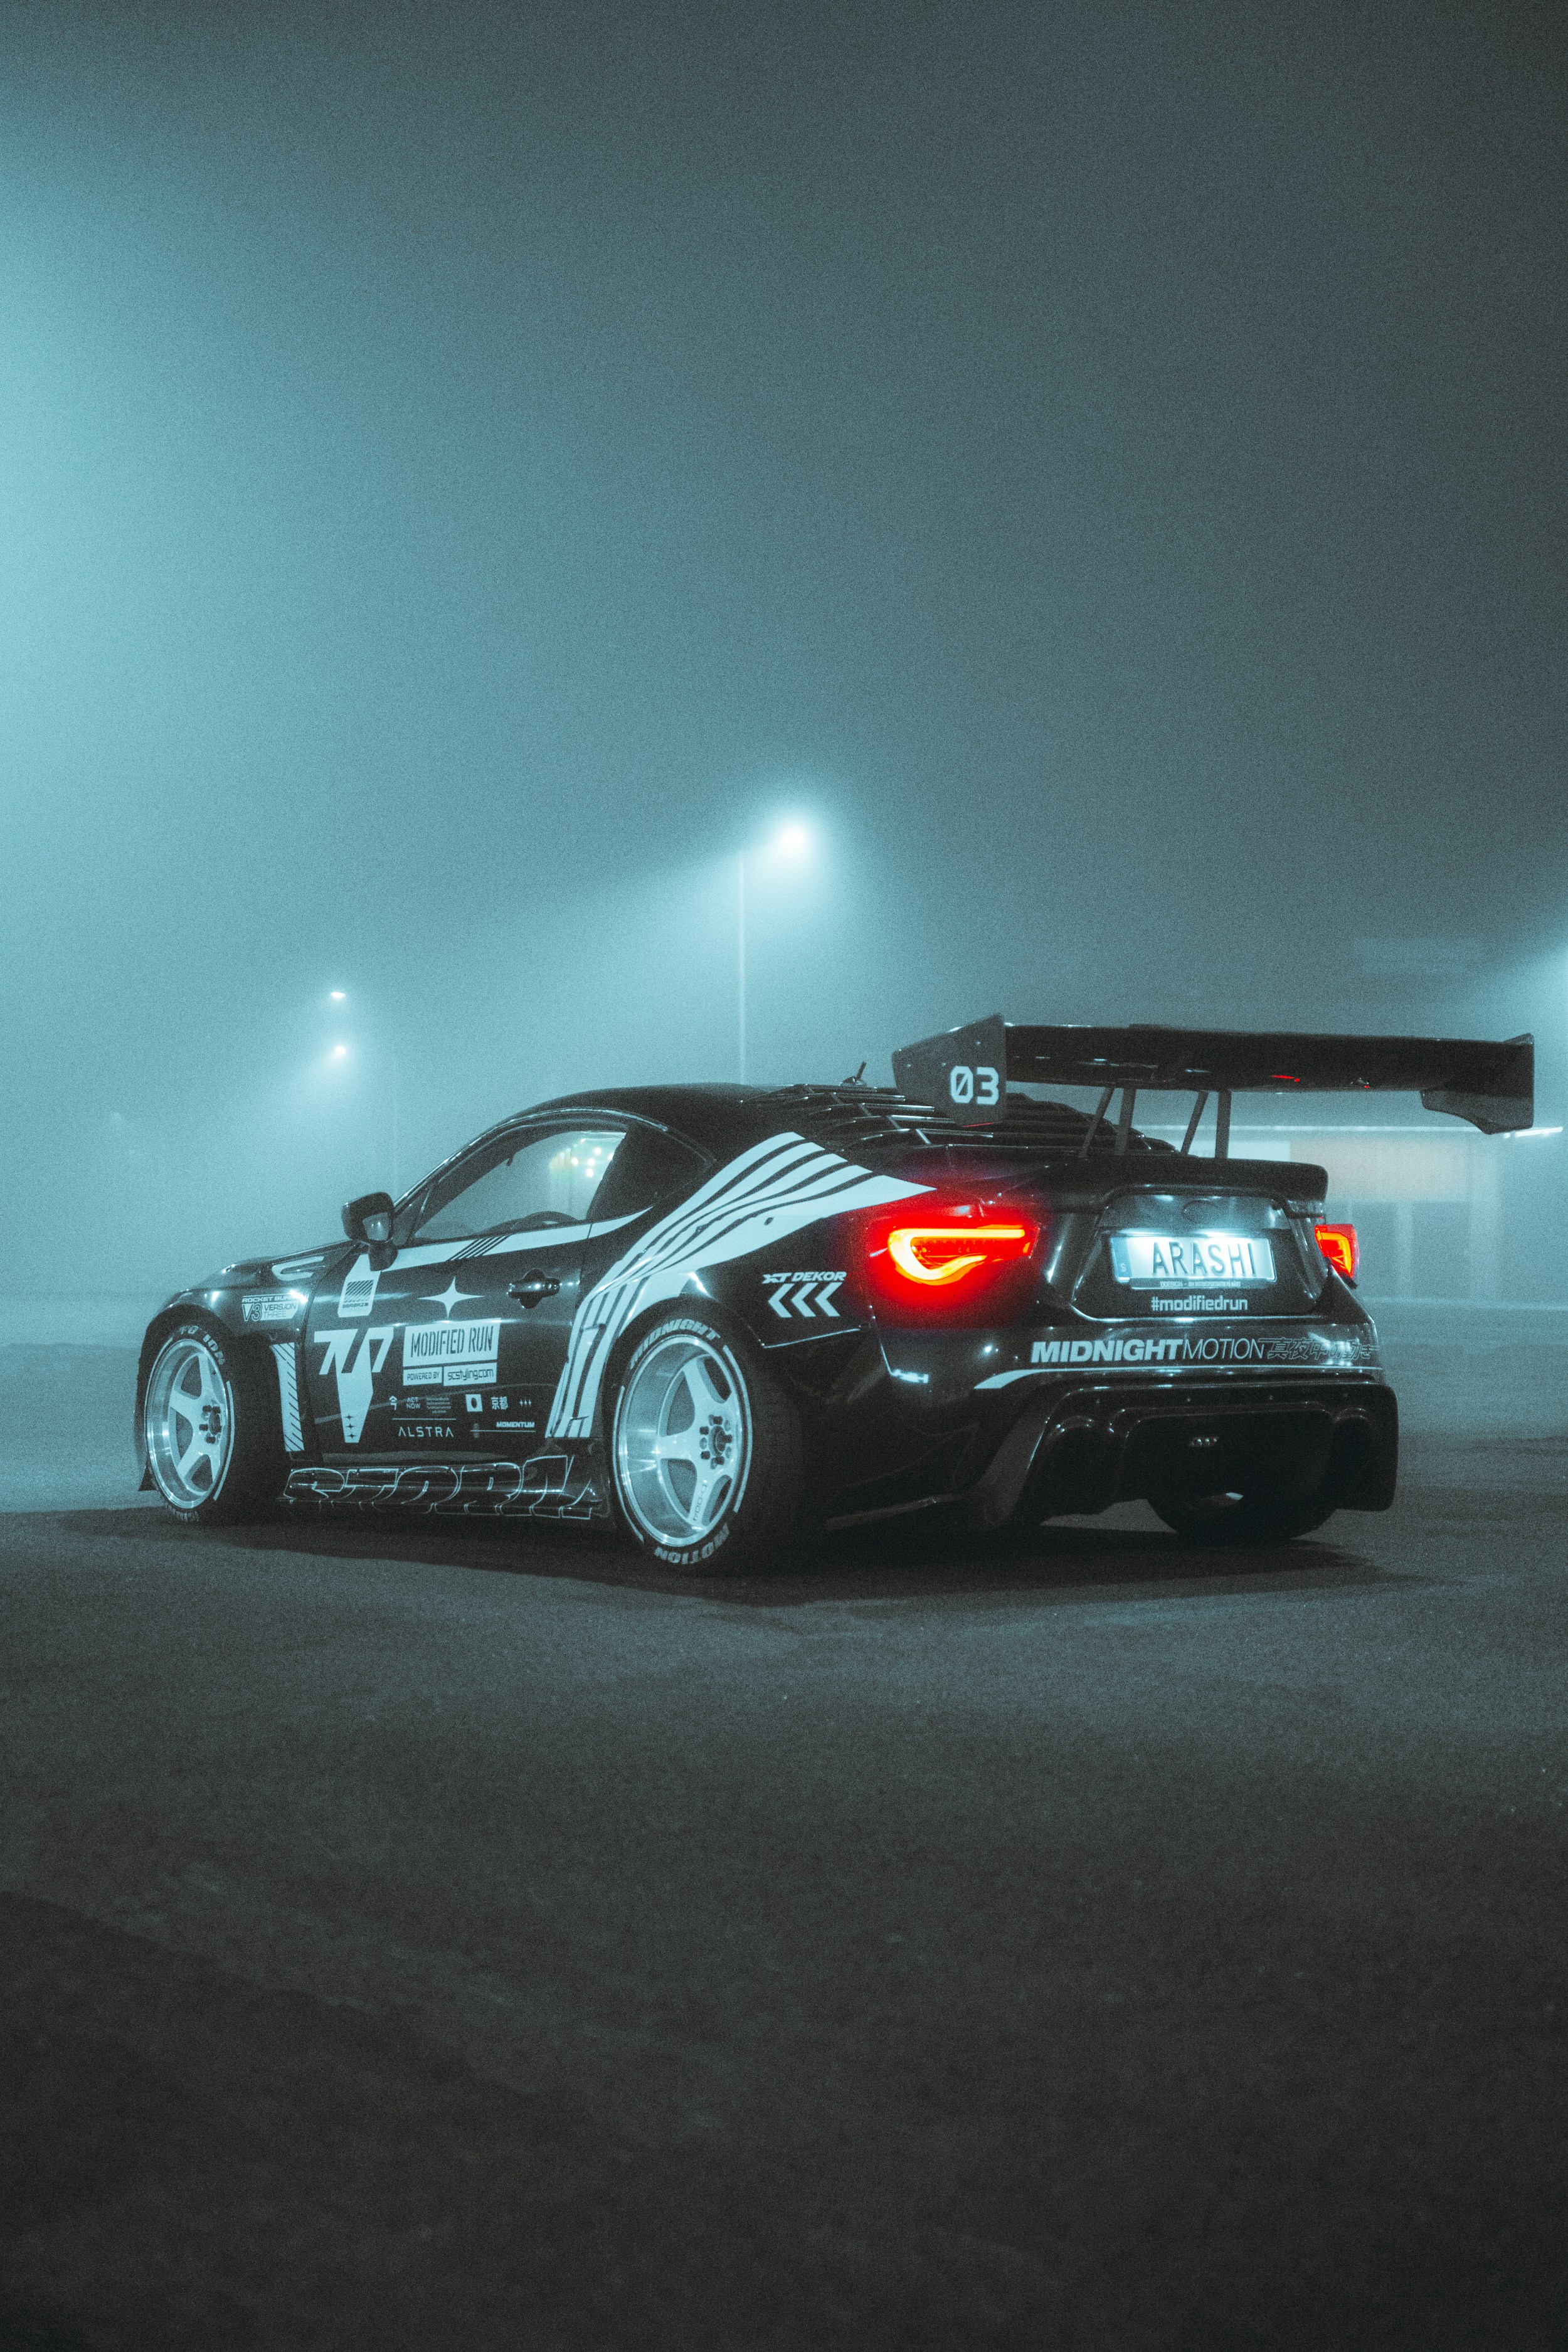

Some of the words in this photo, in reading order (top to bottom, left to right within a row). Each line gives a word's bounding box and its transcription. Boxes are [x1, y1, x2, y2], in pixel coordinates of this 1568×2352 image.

[950, 1066, 999, 1105] 03
[1153, 1241, 1257, 1277] ARASHI
[1120, 1263, 1126, 1272] S
[792, 1271, 847, 1282] DEKOR
[1151, 1295, 1248, 1311] #modifiedrun
[411, 1328, 465, 1358] MODIFIED
[469, 1325, 493, 1353] RUN
[407, 1372, 432, 1380] POWERED
[433, 1371, 440, 1379] BY
[398, 1426, 453, 1438] ALSTRA
